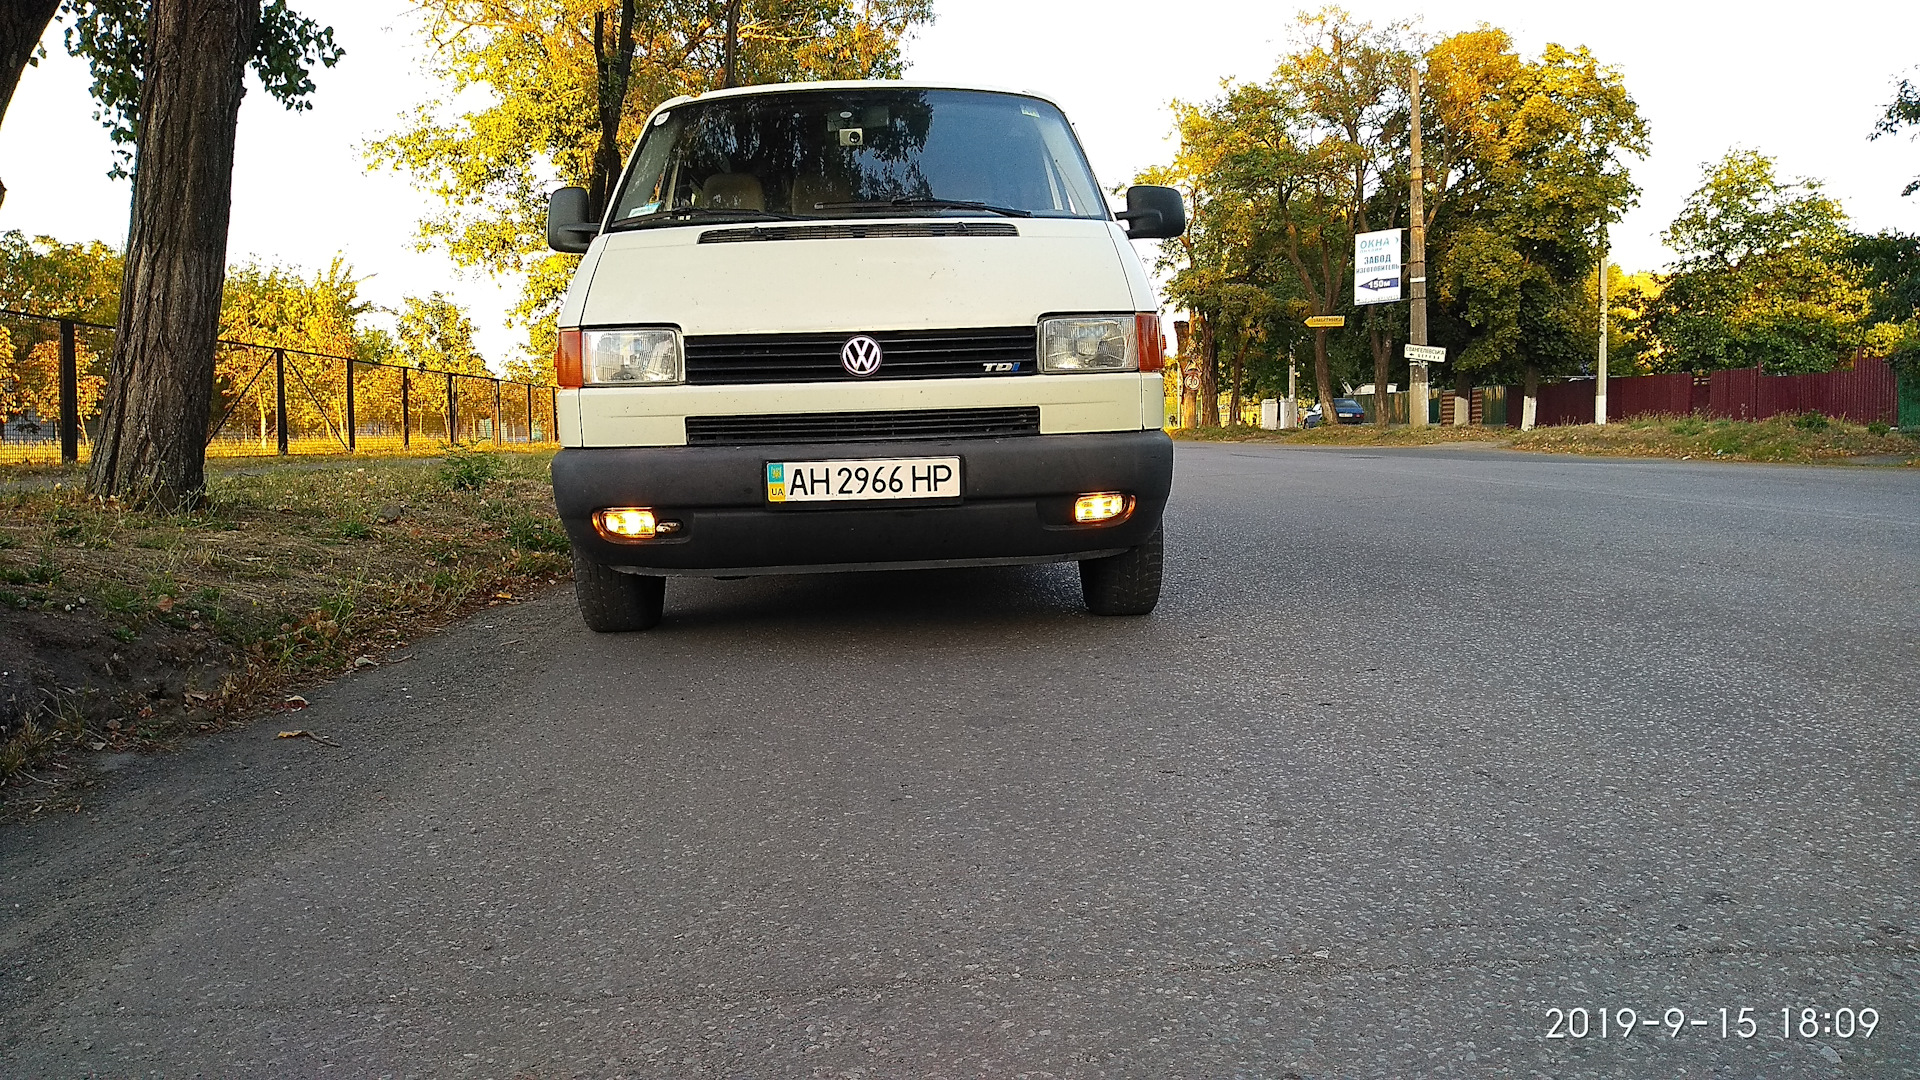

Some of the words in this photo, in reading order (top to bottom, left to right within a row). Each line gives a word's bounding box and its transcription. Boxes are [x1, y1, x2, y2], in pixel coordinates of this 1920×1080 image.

[1360, 237, 1389, 249] ОКНА
[1364, 254, 1391, 264] ЗАВОД
[789, 467, 830, 496] AH
[837, 465, 904, 495] 2966
[911, 464, 952, 493] HP
[771, 487, 784, 496] UA
